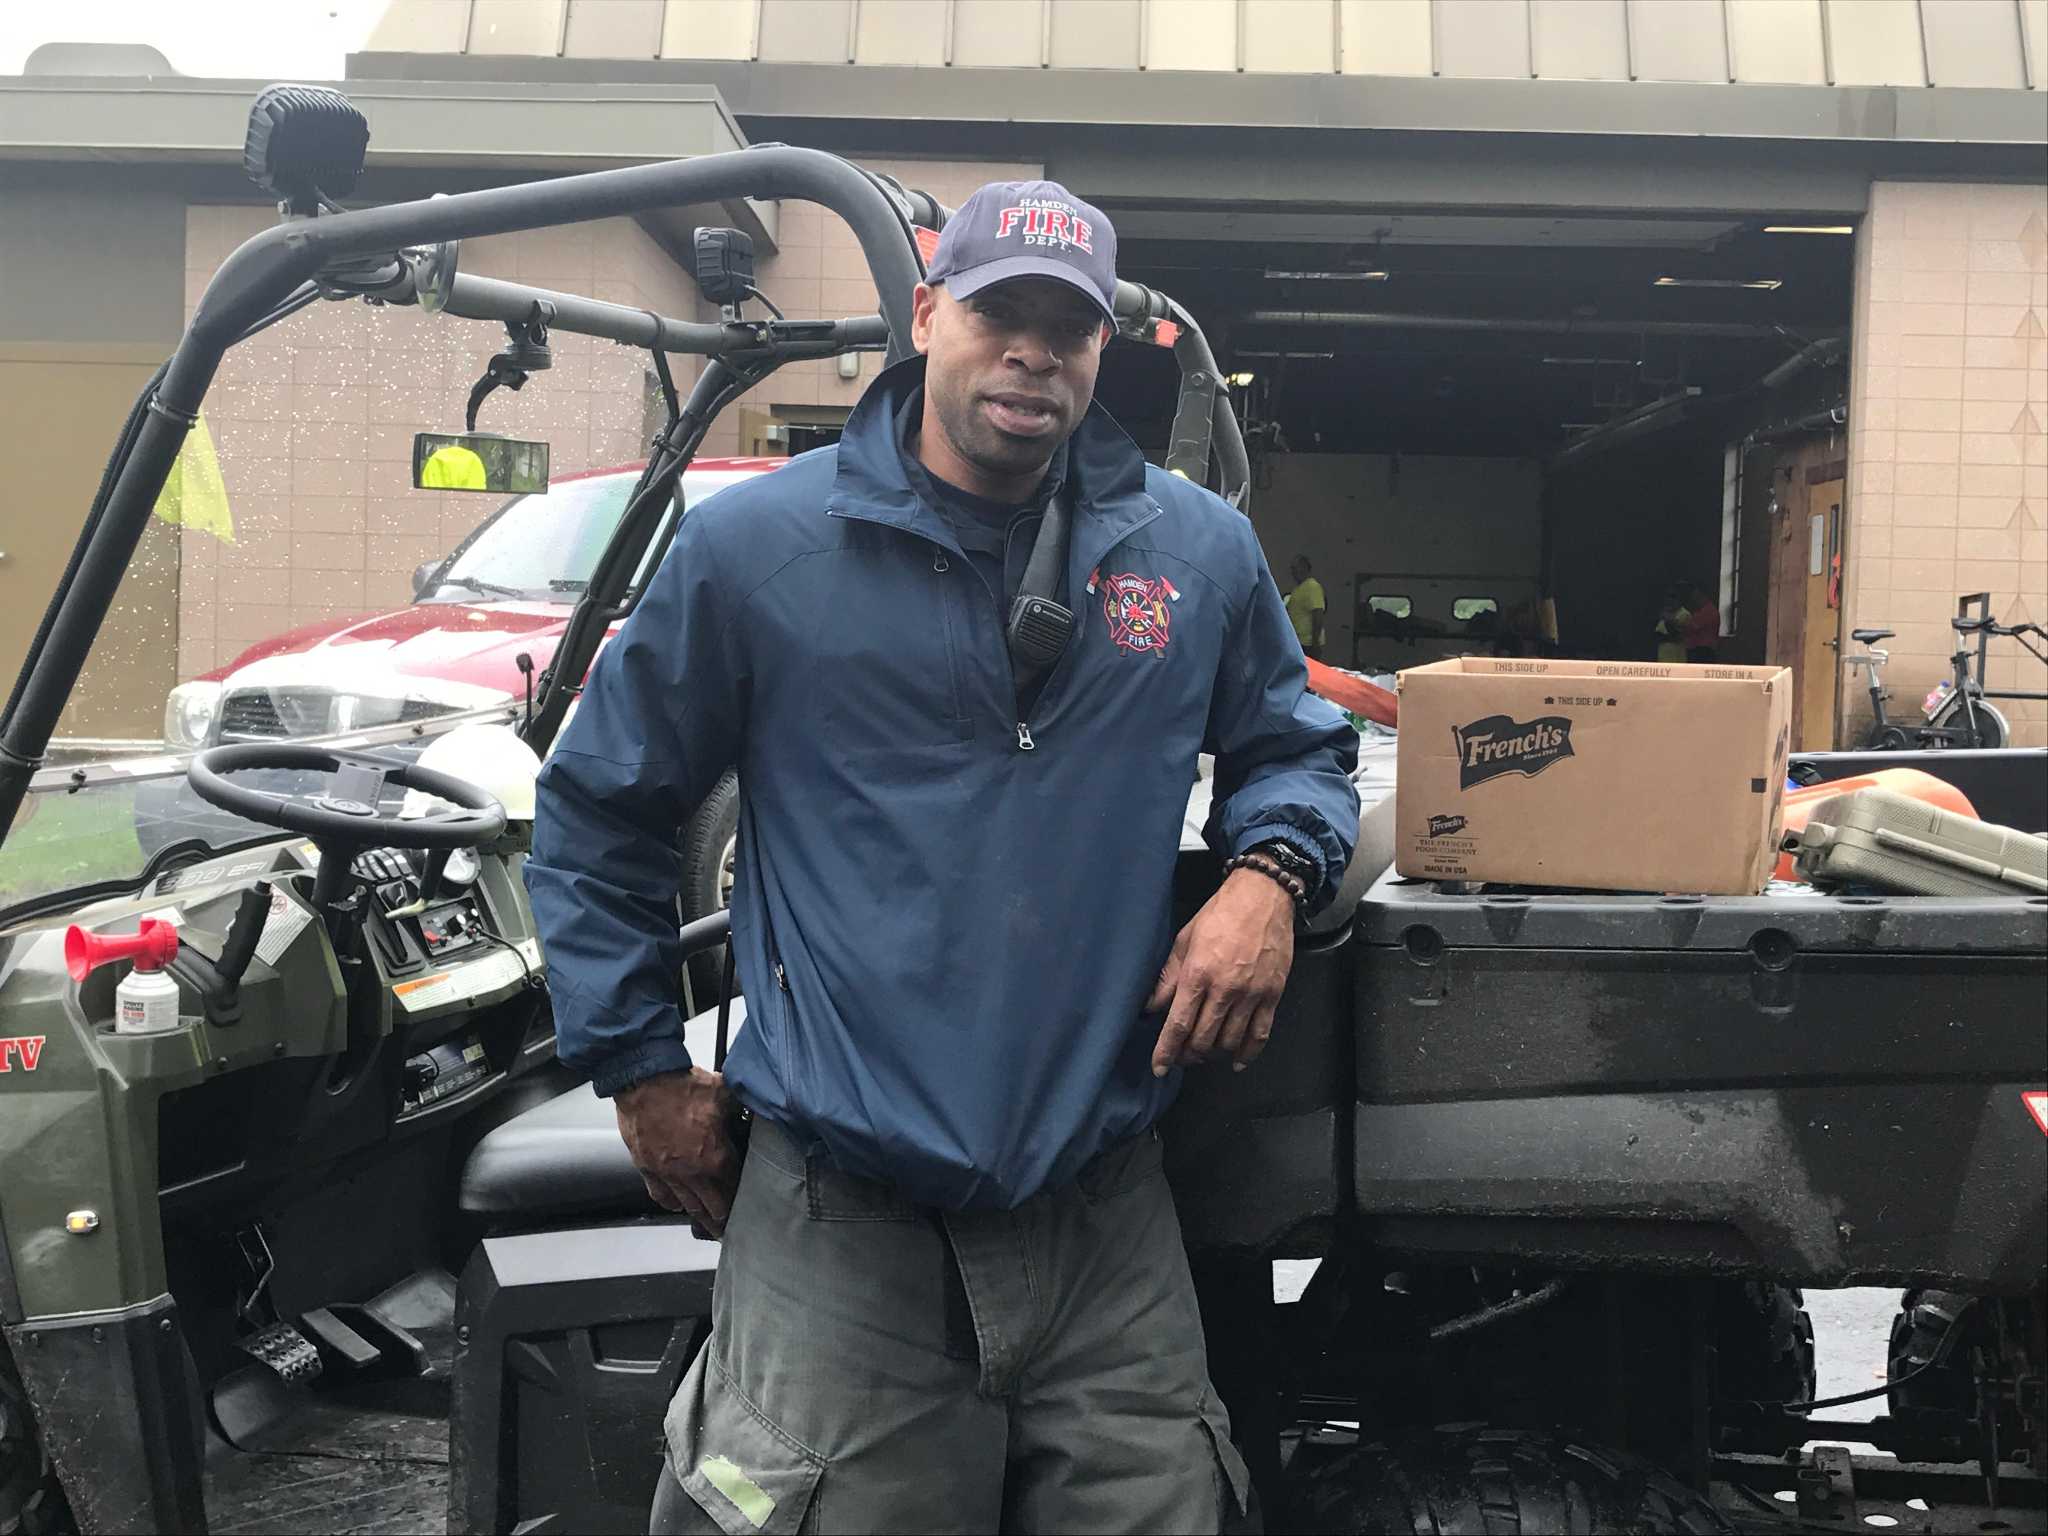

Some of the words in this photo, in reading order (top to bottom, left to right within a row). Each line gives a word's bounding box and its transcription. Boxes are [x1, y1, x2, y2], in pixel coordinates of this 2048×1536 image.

[1019, 199, 1078, 217] HAMDEN
[995, 207, 1093, 256] FIRE
[1023, 235, 1072, 254] DEPT.
[1128, 634, 1153, 647] FIRE
[1495, 662, 1513, 672] THIS
[1515, 663, 1535, 673] SIDE
[1536, 663, 1549, 673] UP
[1596, 665, 1619, 676] OPEN
[1622, 666, 1672, 678] CAREFULLY
[1704, 669, 1734, 680] STORE
[1736, 670, 1745, 680] IN
[1558, 697, 1574, 705] THIS
[1576, 697, 1592, 706] SIDE
[1593, 697, 1603, 706] UP
[1465, 723, 1563, 768] French's
